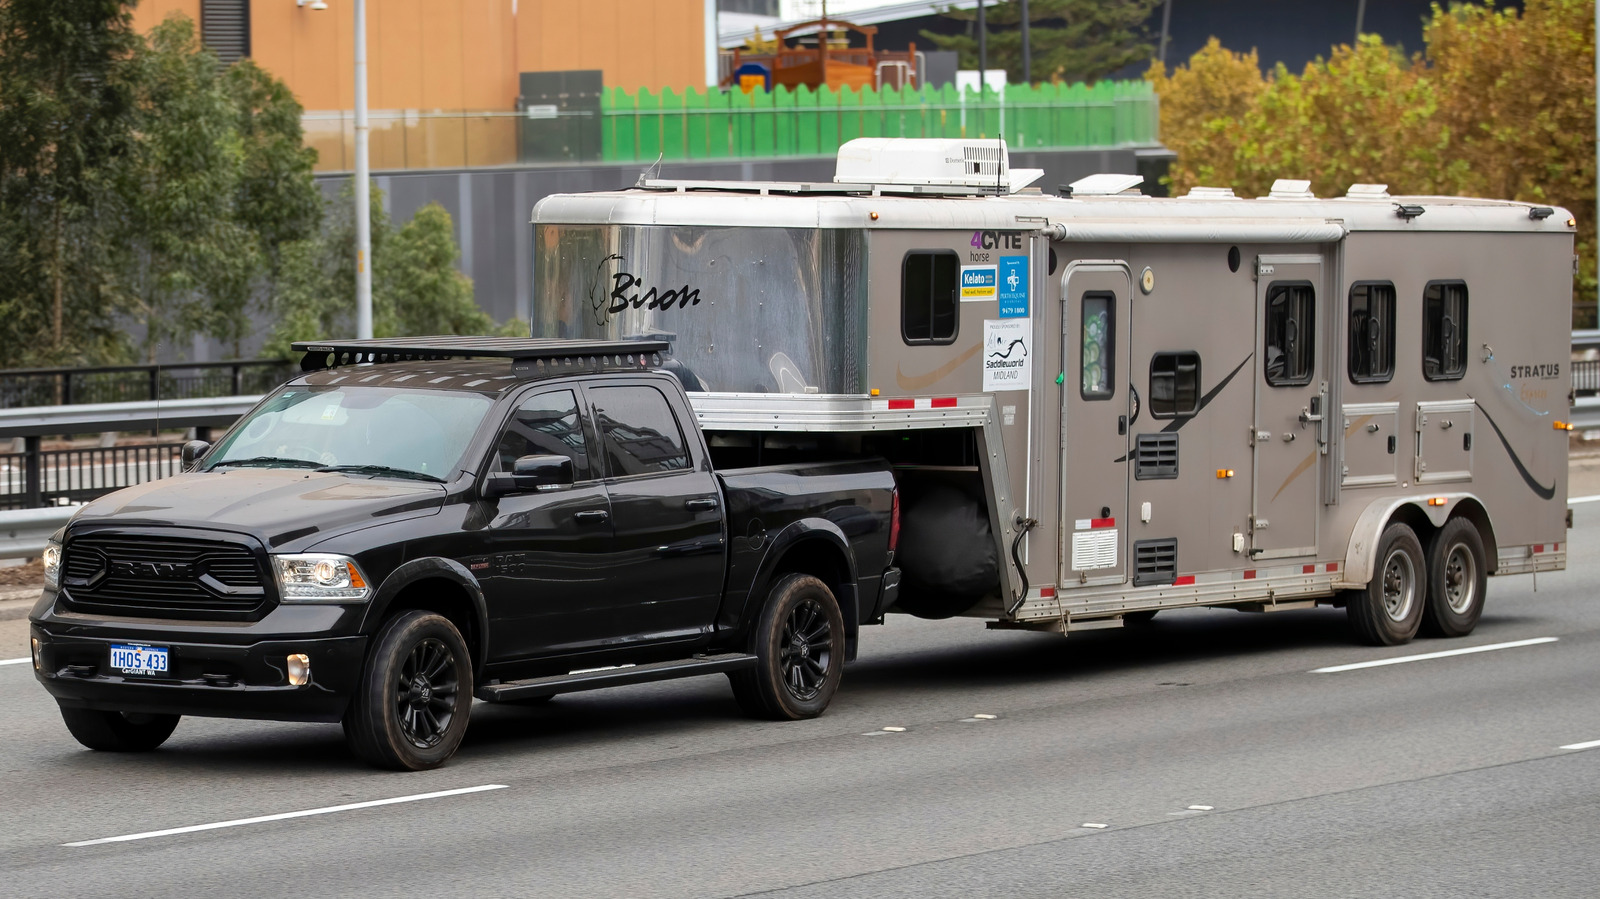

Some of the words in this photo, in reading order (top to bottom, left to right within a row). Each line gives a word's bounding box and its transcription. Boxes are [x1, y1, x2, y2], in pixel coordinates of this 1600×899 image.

[970, 231, 1022, 250] 4CYTE
[970, 250, 990, 262] horse
[964, 272, 985, 284] Kelato
[608, 272, 701, 314] Bison
[986, 358, 1025, 369] Saddleworld
[993, 370, 1019, 380] MIDLAND
[1510, 364, 1560, 378] STRATUS
